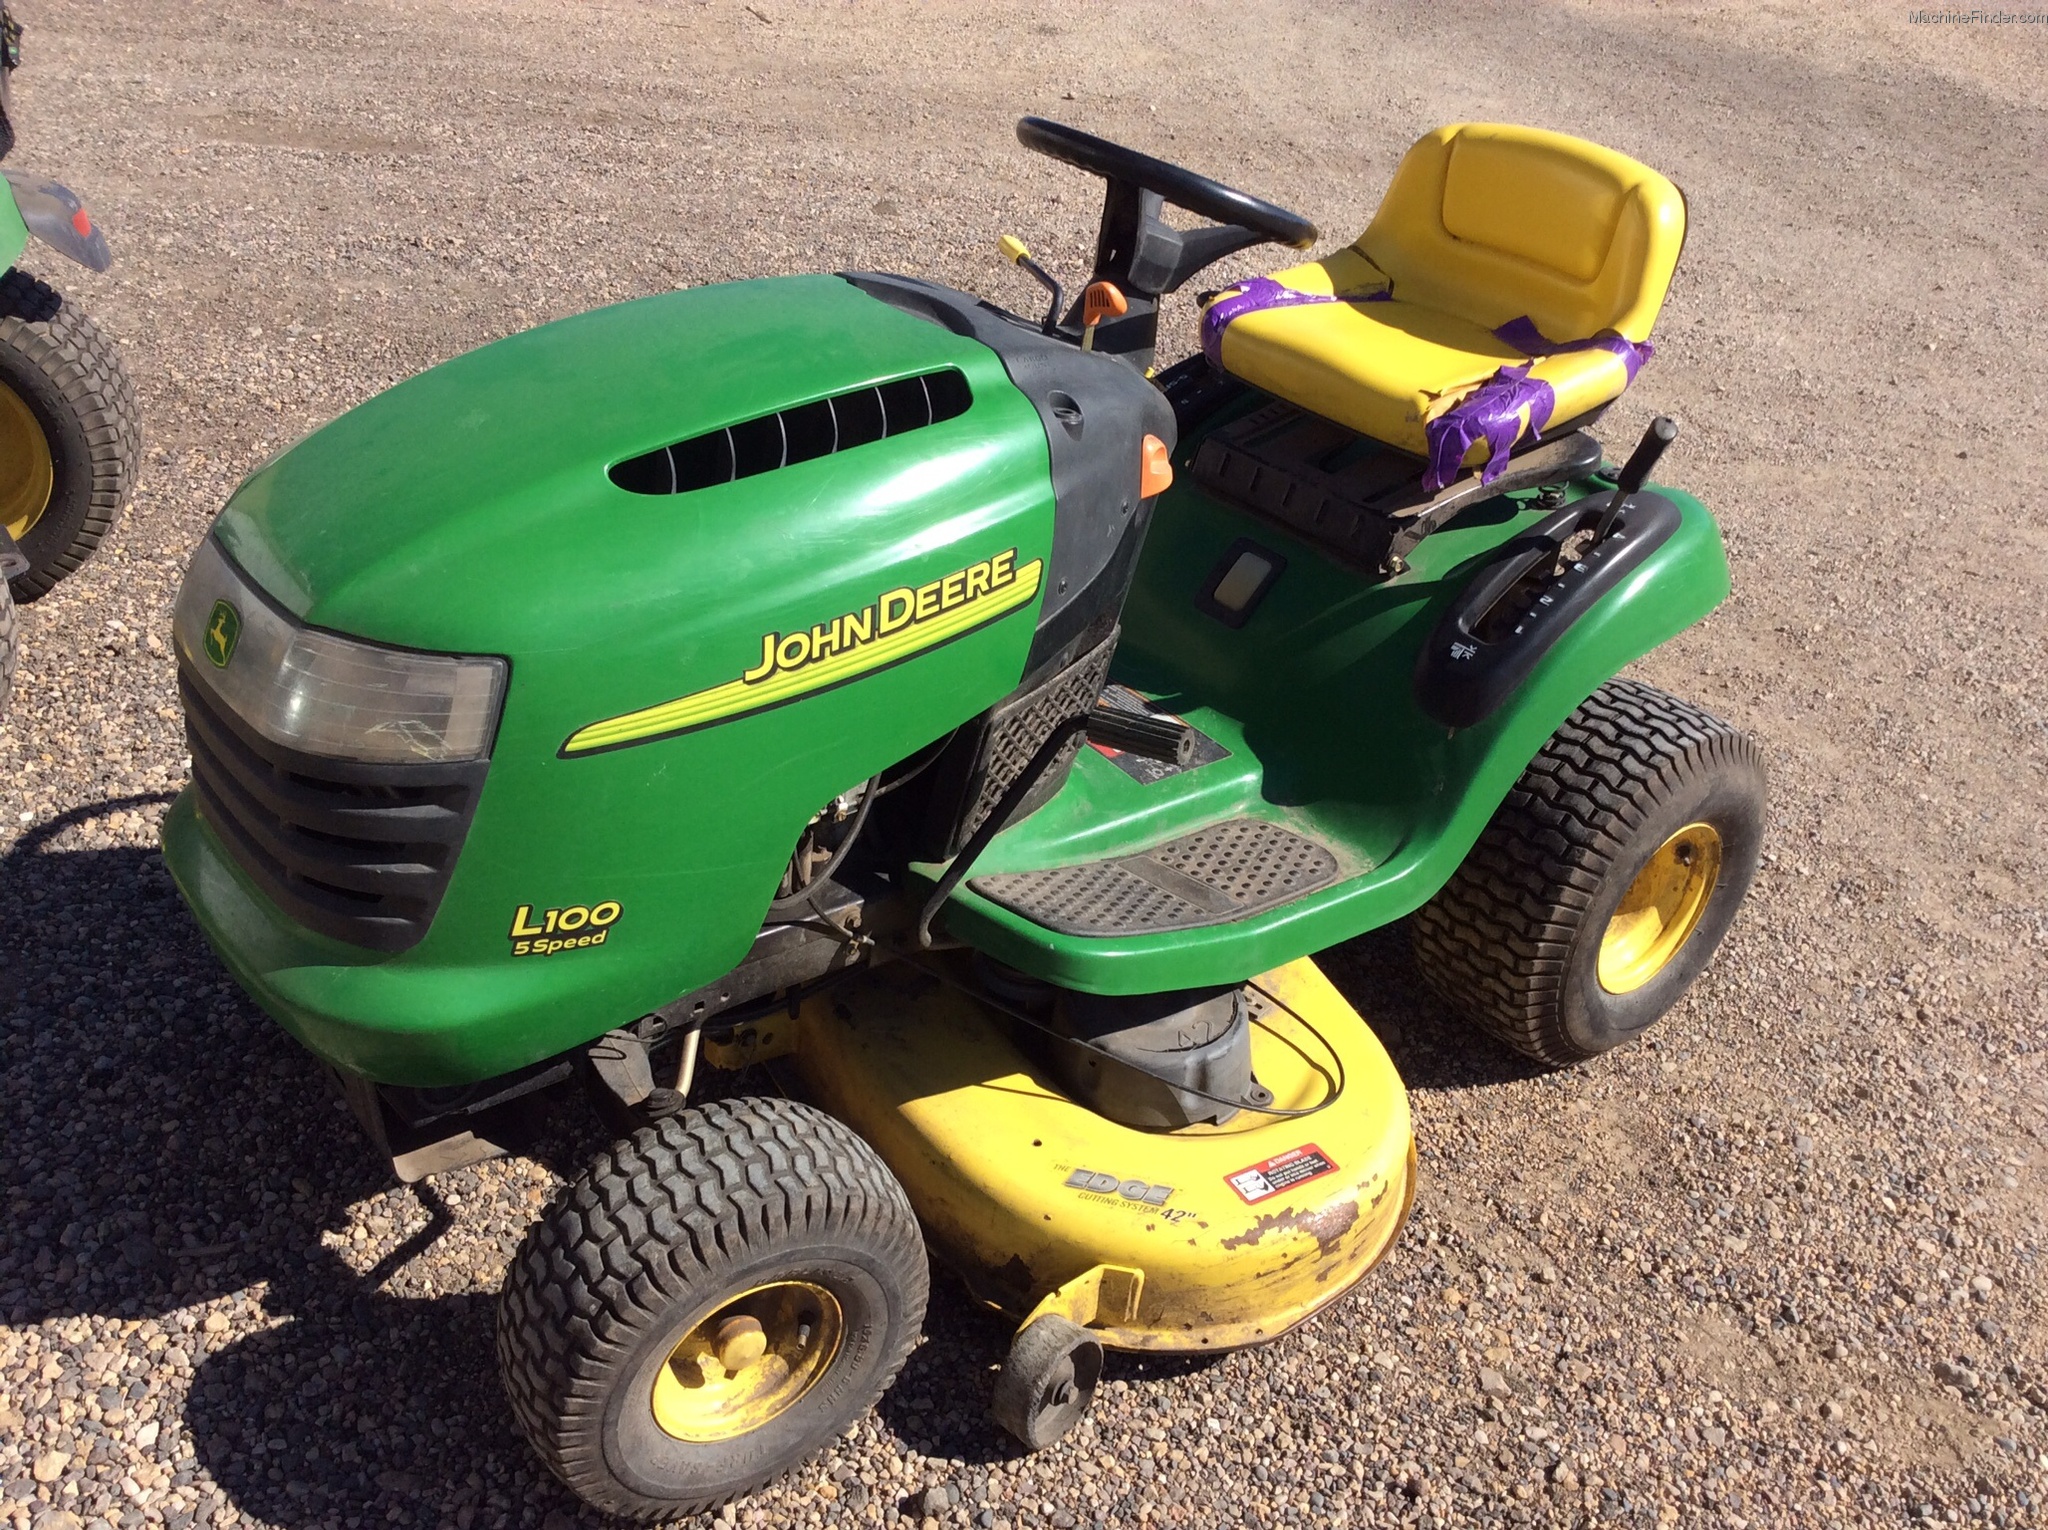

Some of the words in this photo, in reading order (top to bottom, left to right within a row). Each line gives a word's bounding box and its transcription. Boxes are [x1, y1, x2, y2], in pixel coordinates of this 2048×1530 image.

[744, 606, 875, 683] JOHN
[878, 547, 1017, 635] DEERE
[510, 900, 622, 938] L100
[513, 940, 531, 955] 5
[532, 929, 608, 955] Speed
[1053, 1164, 1071, 1173] THE
[1065, 1168, 1175, 1207] EDGE
[1077, 1192, 1119, 1206] CUTTING
[1120, 1201, 1160, 1215] SYSTEM
[1160, 1208, 1197, 1223] 42"
